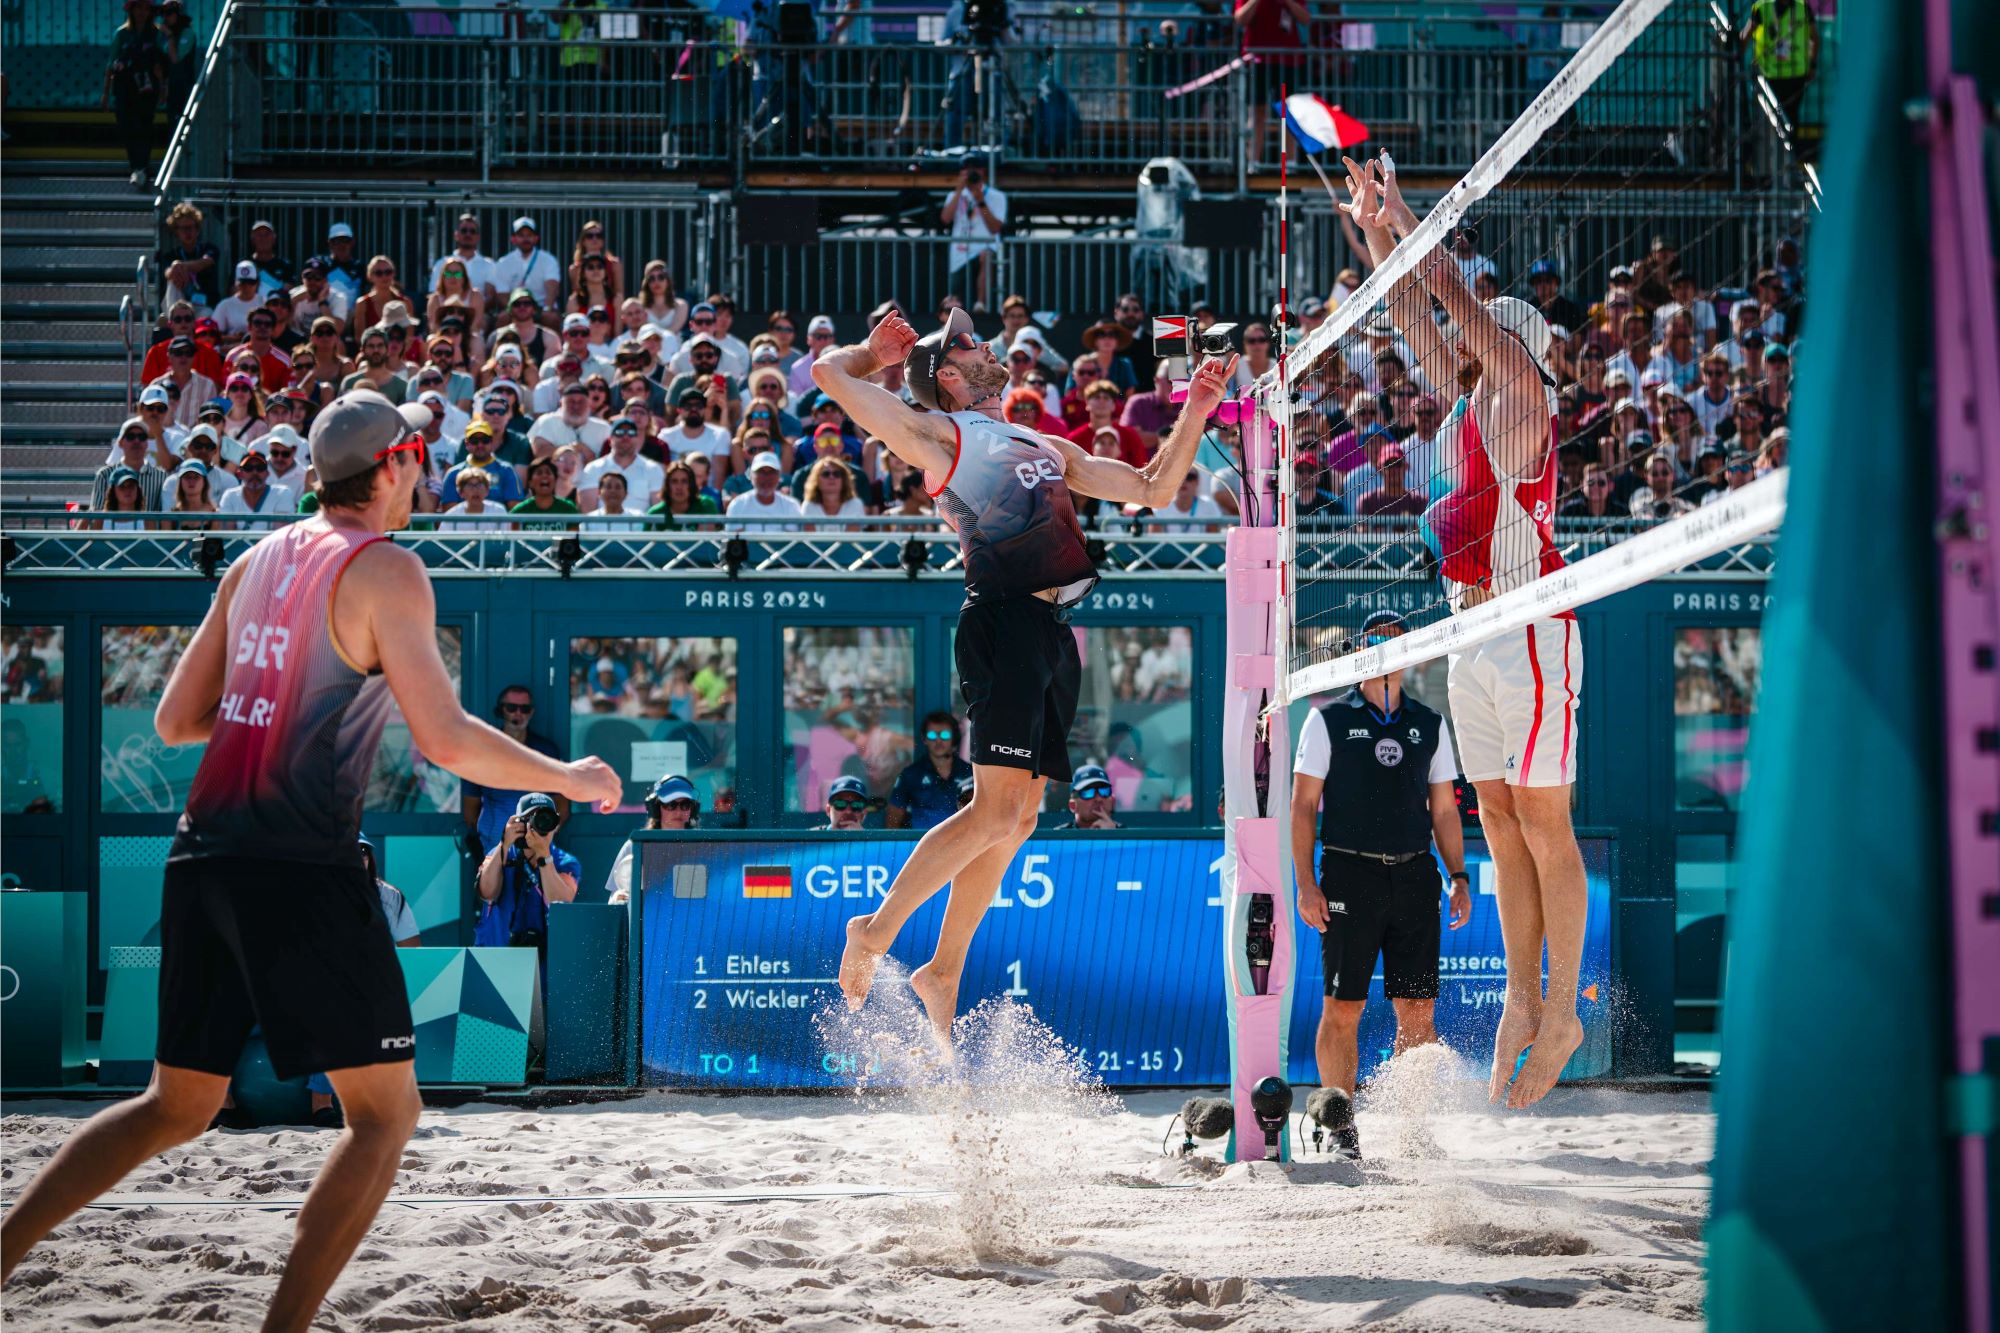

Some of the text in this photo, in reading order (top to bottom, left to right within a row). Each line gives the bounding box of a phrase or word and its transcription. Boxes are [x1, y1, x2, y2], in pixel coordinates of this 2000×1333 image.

[976, 428, 1009, 456] 2
[685, 590, 826, 608] PARIS 2024
[1092, 592, 1154, 609] 2024
[1673, 592, 1740, 610] PARIS
[805, 865, 889, 898] GER
[695, 954, 791, 975] 1 Ehlers
[1006, 959, 1028, 996] 1
[694, 987, 809, 1009] 2 Wickler
[699, 1053, 760, 1073] TO 1
